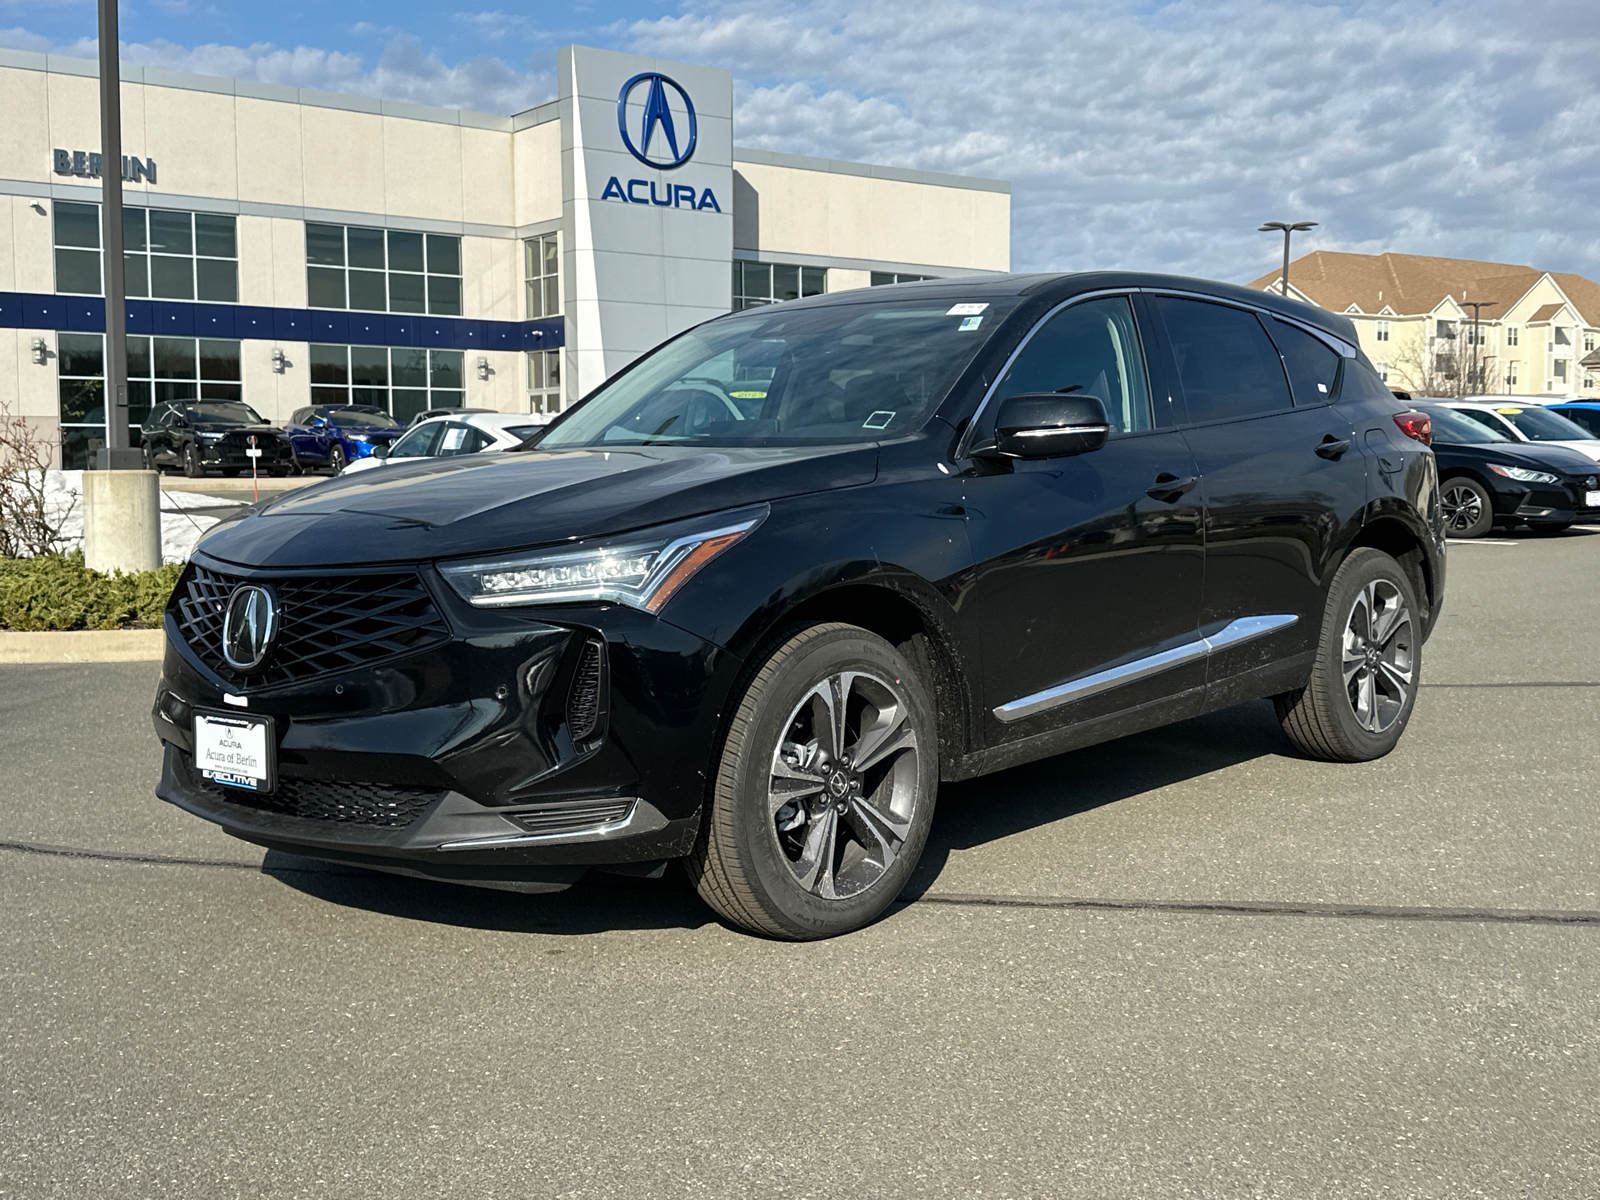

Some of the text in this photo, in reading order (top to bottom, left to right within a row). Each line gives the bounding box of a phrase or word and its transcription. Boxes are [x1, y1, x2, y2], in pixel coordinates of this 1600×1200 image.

[54, 148, 155, 182] BERIN
[601, 176, 721, 213] ACURA
[219, 739, 242, 749] ACURA
[206, 748, 257, 768] Acura of Berlin
[202, 769, 257, 787] EXECUTIVE
